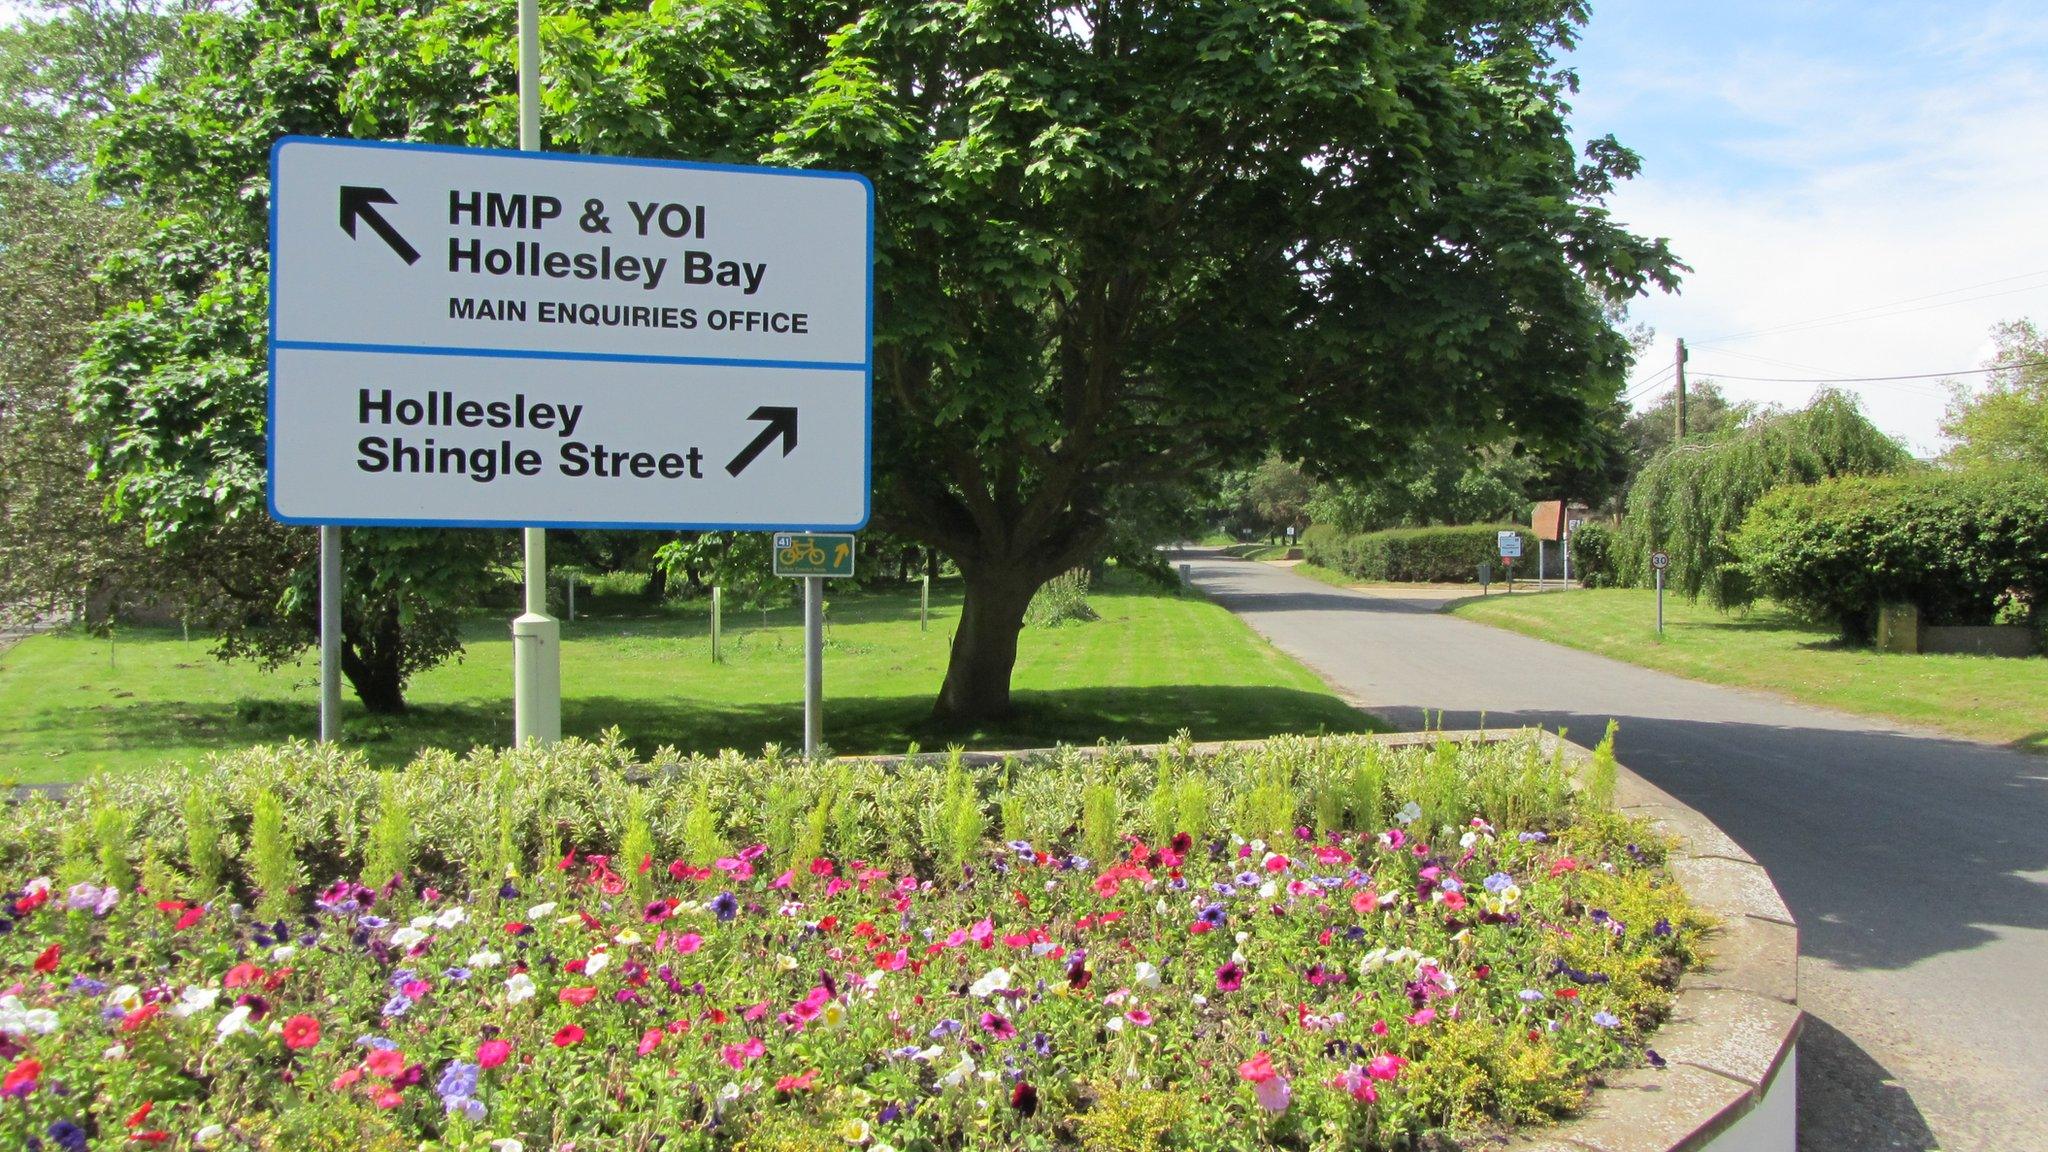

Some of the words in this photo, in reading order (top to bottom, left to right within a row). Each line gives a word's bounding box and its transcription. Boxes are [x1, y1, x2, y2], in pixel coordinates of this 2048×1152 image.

[450, 190, 561, 229] HMP
[580, 199, 611, 233] &
[628, 202, 704, 238] YOI
[449, 238, 667, 290] Hollesley
[685, 251, 766, 294] Bay
[450, 298, 526, 321] MAIN
[539, 302, 697, 329] ENQUIRIES
[708, 310, 808, 333] OFFICE
[360, 389, 582, 437] Hollesley
[358, 437, 542, 482] Shingle
[560, 442, 703, 478] Street
[778, 537, 789, 546] 41
[1655, 556, 1666, 565] 30
